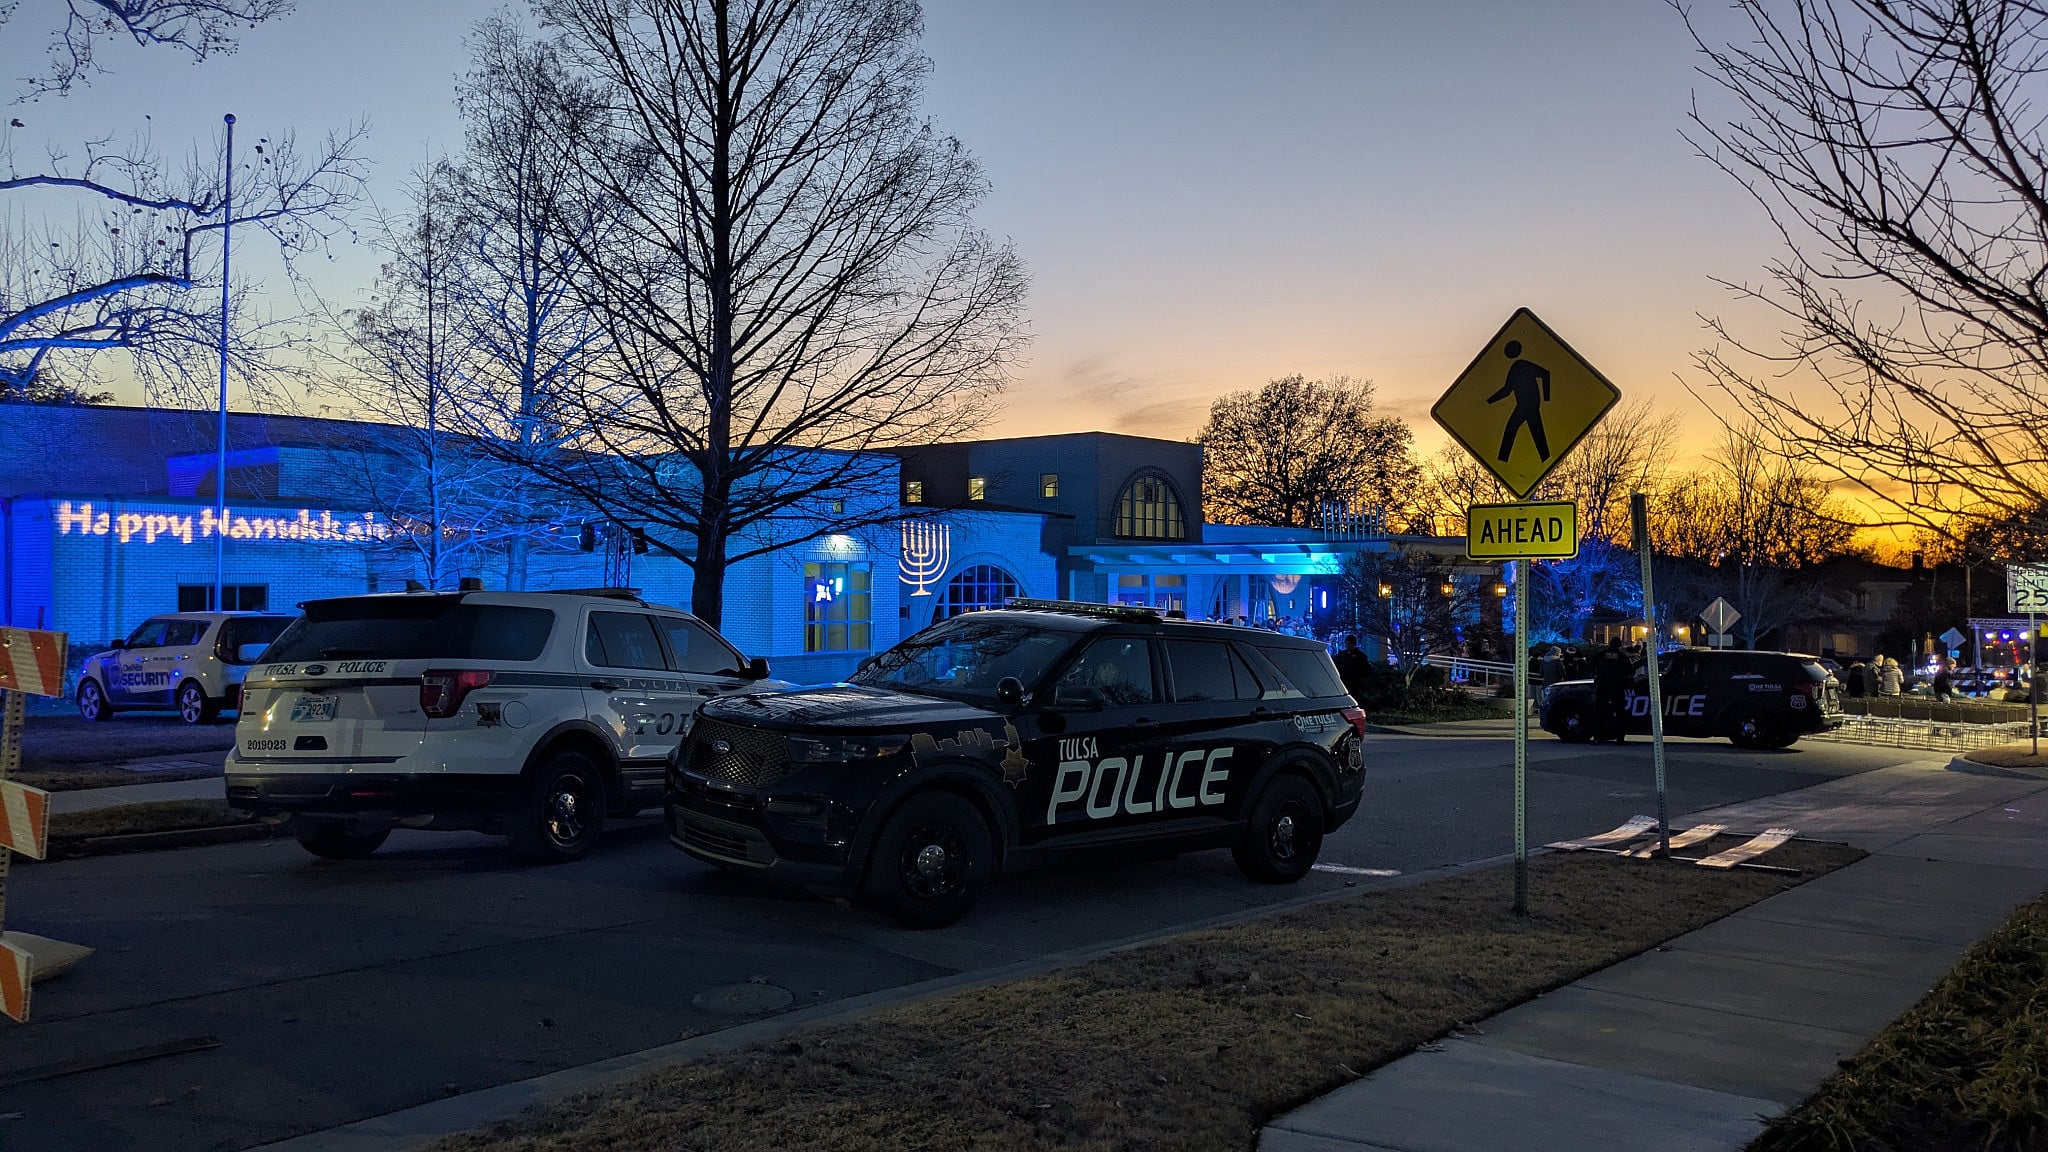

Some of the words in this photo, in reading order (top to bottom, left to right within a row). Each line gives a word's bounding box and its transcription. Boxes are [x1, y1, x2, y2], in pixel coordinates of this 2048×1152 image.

[57, 500, 193, 544] Happy
[1480, 517, 1563, 544] AHEAD
[2016, 579, 2045, 587] LIMIT
[2015, 590, 2048, 607] 25
[264, 664, 298, 676] TULSA
[336, 661, 387, 673] POLICE
[121, 671, 171, 686] SECURITY
[623, 678, 682, 691] TULSA
[1624, 694, 1707, 717] POICE
[1294, 714, 1315, 729] ONE
[1315, 713, 1337, 725] TULSA
[247, 739, 287, 751] 2019023
[1058, 736, 1099, 761] TULSA
[1046, 746, 1235, 825] POLICE
